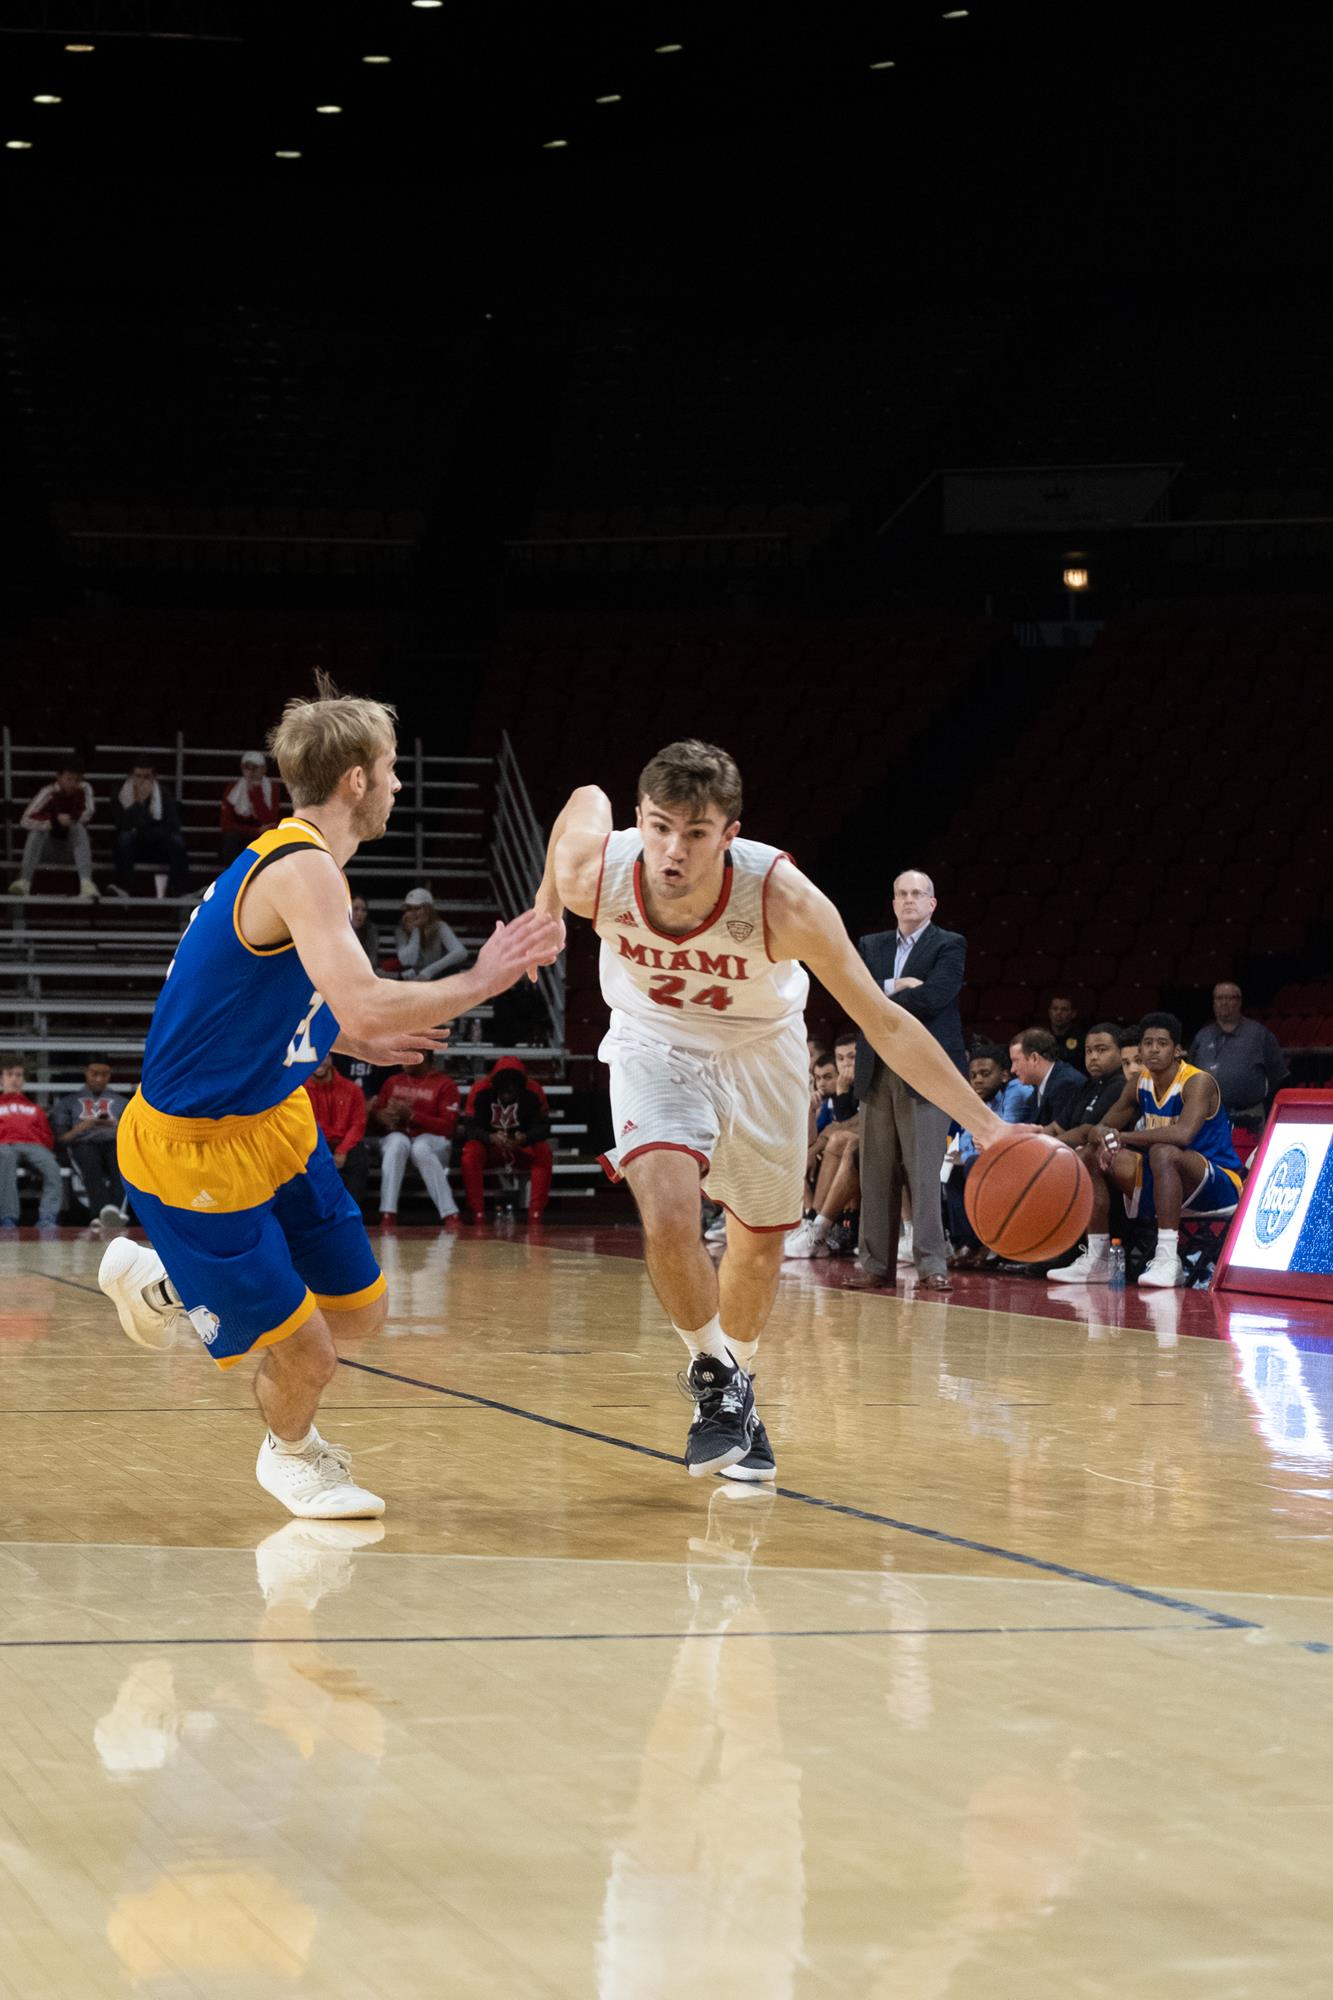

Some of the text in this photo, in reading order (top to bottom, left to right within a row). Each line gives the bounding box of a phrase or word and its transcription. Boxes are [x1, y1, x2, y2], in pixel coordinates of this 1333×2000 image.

[616, 934, 750, 980] MIAMI
[648, 974, 733, 1011] 24
[77, 1097, 115, 1121] M
[490, 1102, 520, 1129] M
